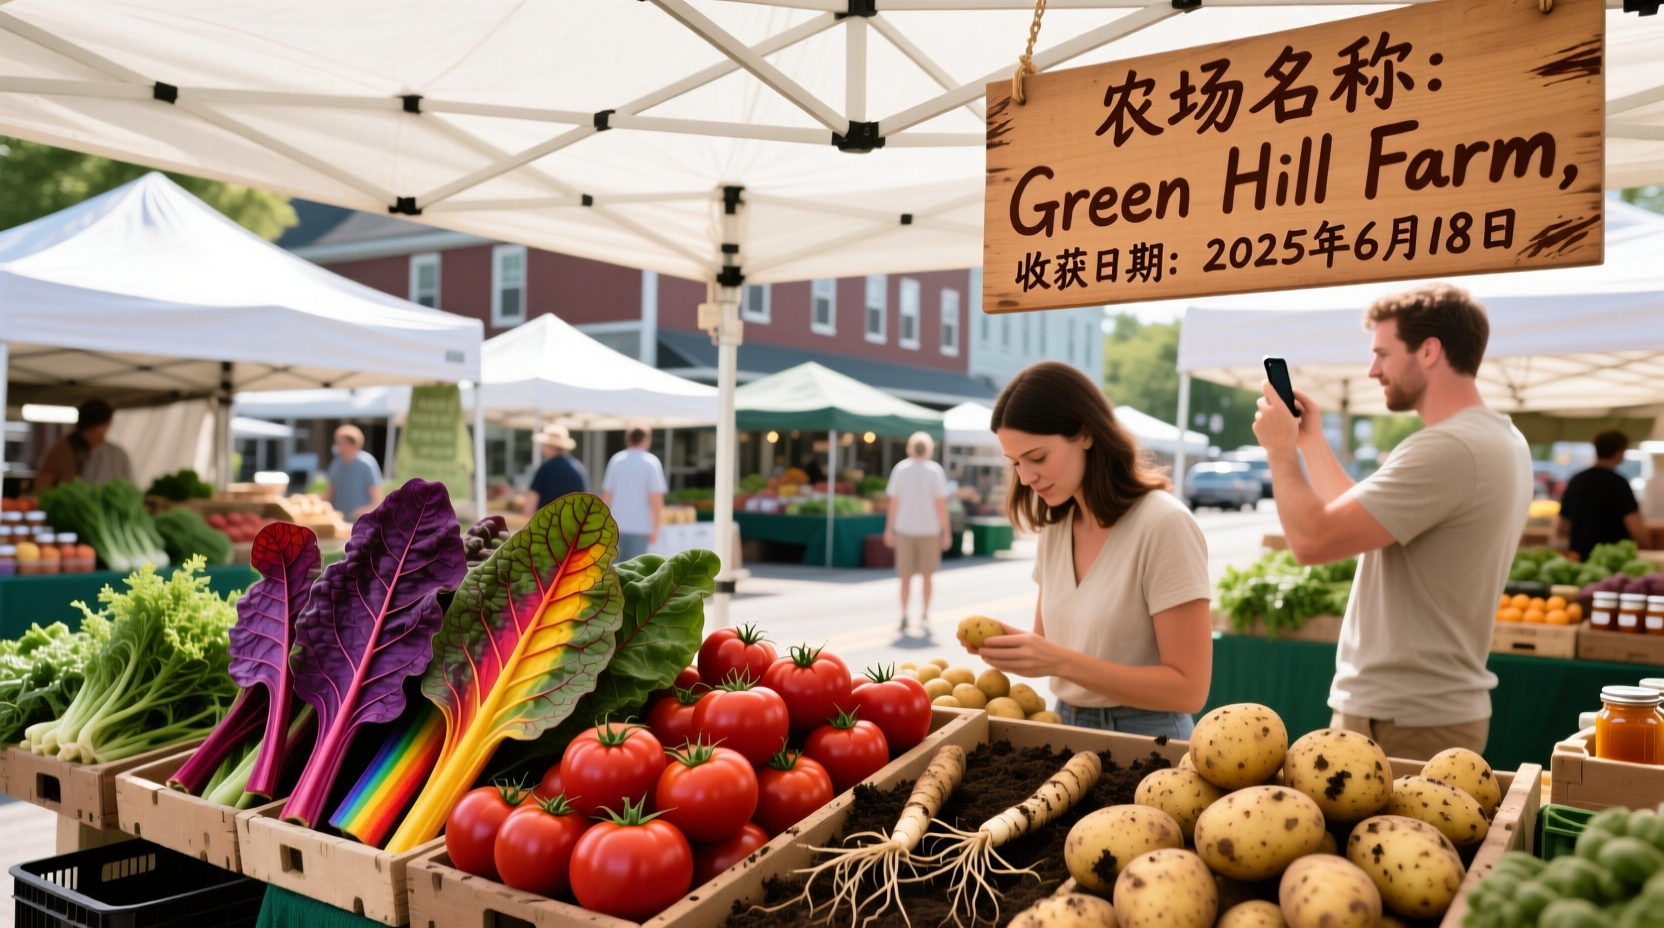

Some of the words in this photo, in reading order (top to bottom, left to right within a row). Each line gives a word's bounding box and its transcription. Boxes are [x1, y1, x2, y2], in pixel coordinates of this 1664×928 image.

[1094, 30, 1444, 148] 农场名称：
[1009, 165, 1190, 238] Green
[1222, 132, 1333, 215] Hill
[1364, 119, 1579, 200] Farm,
